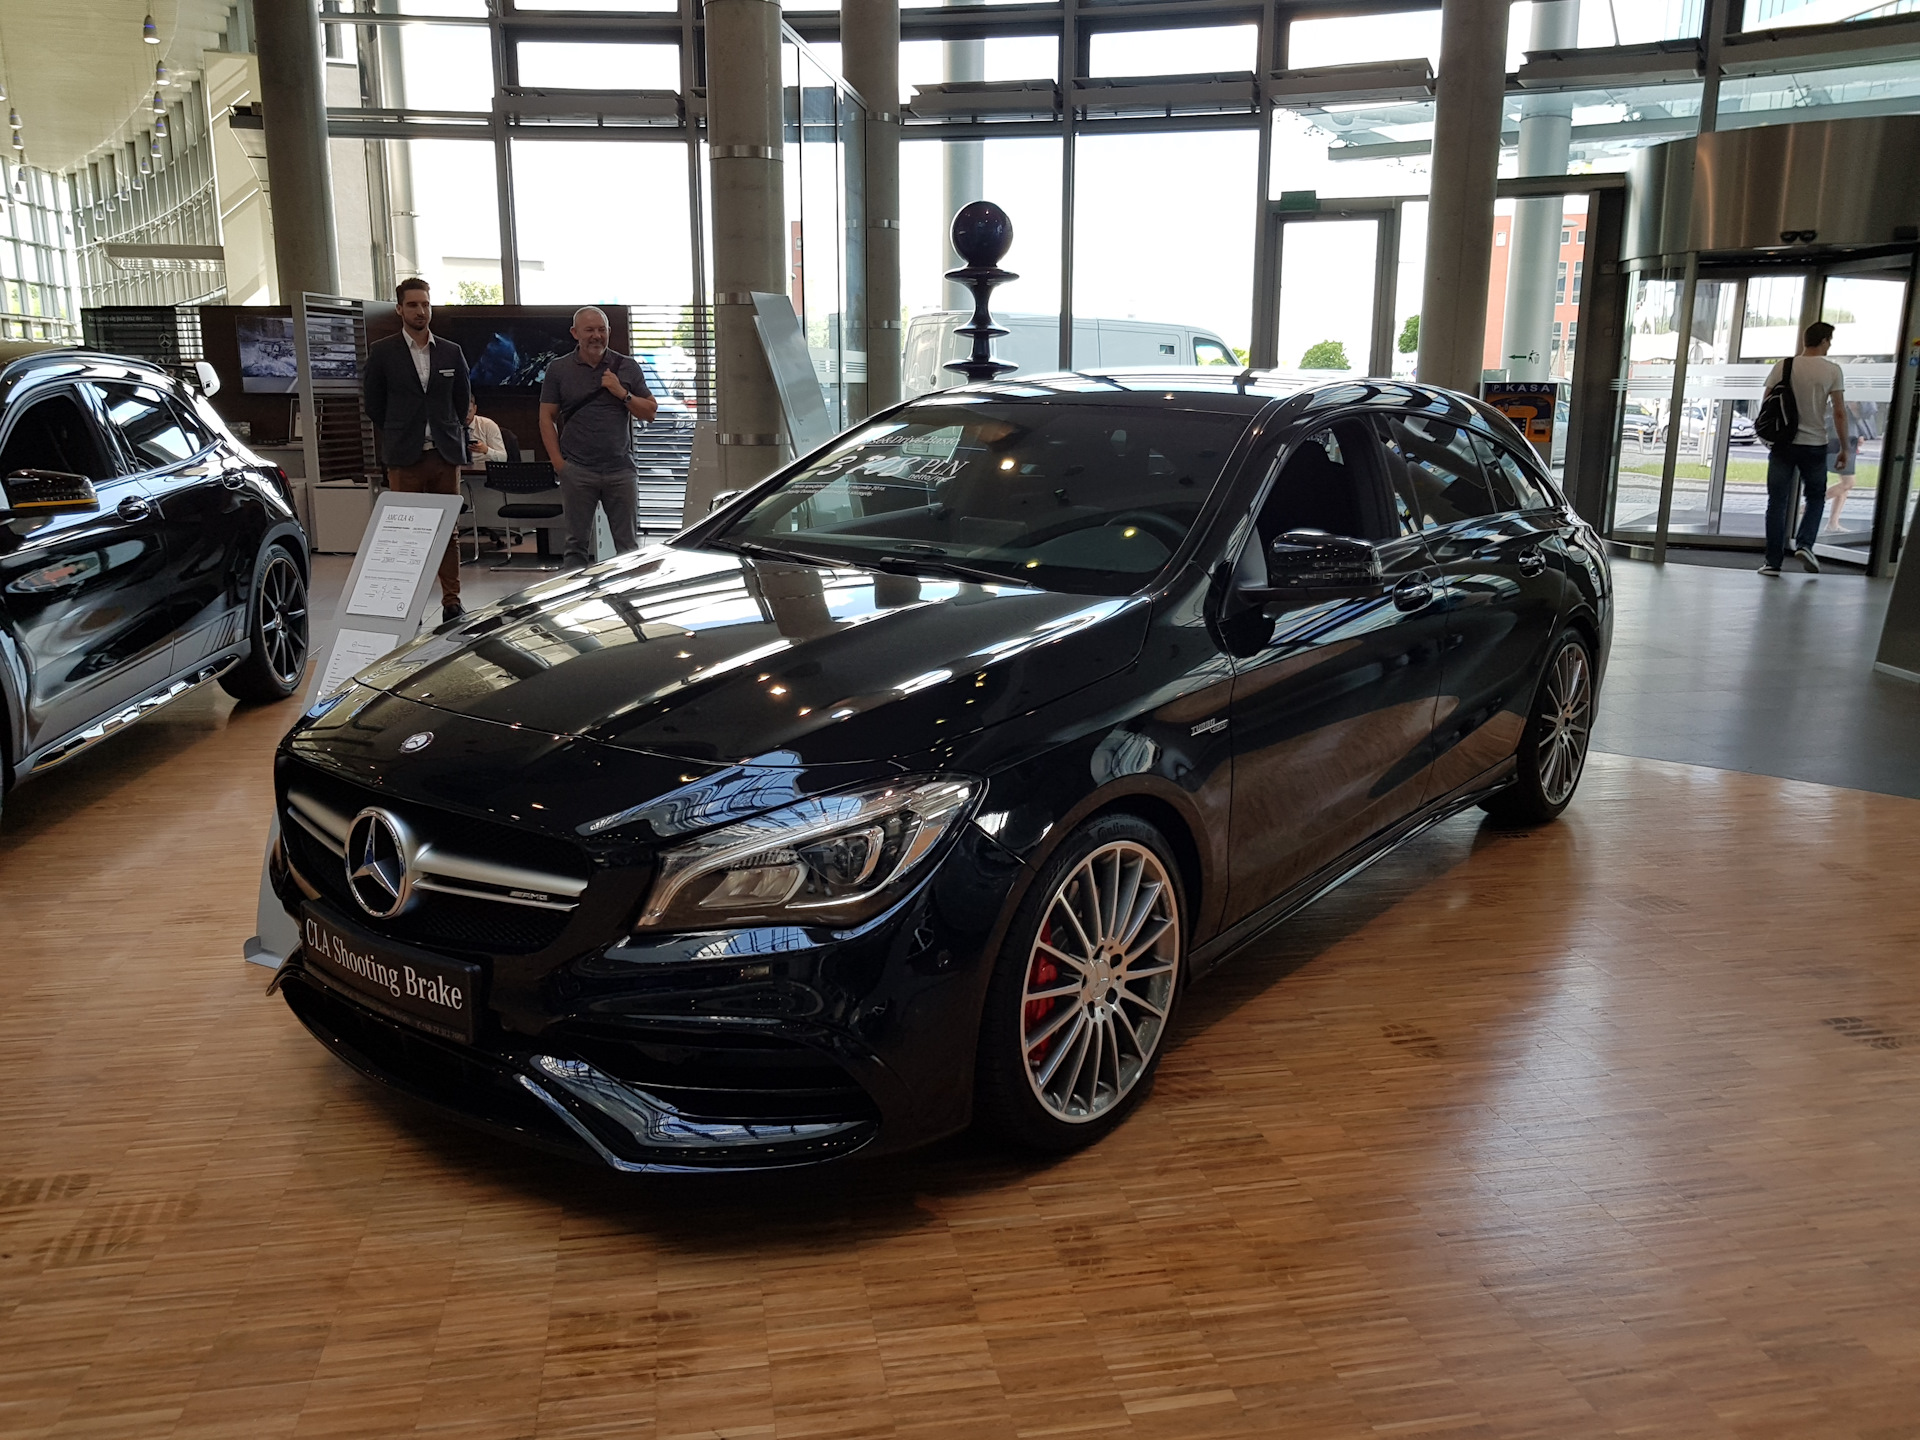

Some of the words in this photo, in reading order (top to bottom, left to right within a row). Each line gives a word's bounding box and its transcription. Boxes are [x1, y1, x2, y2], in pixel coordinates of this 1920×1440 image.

[1505, 384, 1551, 392] KASA
[817, 455, 858, 476] 3
[916, 458, 970, 476] PLN
[306, 918, 331, 958] CLA
[332, 935, 401, 997] Shooting
[403, 965, 463, 1010] Brake
